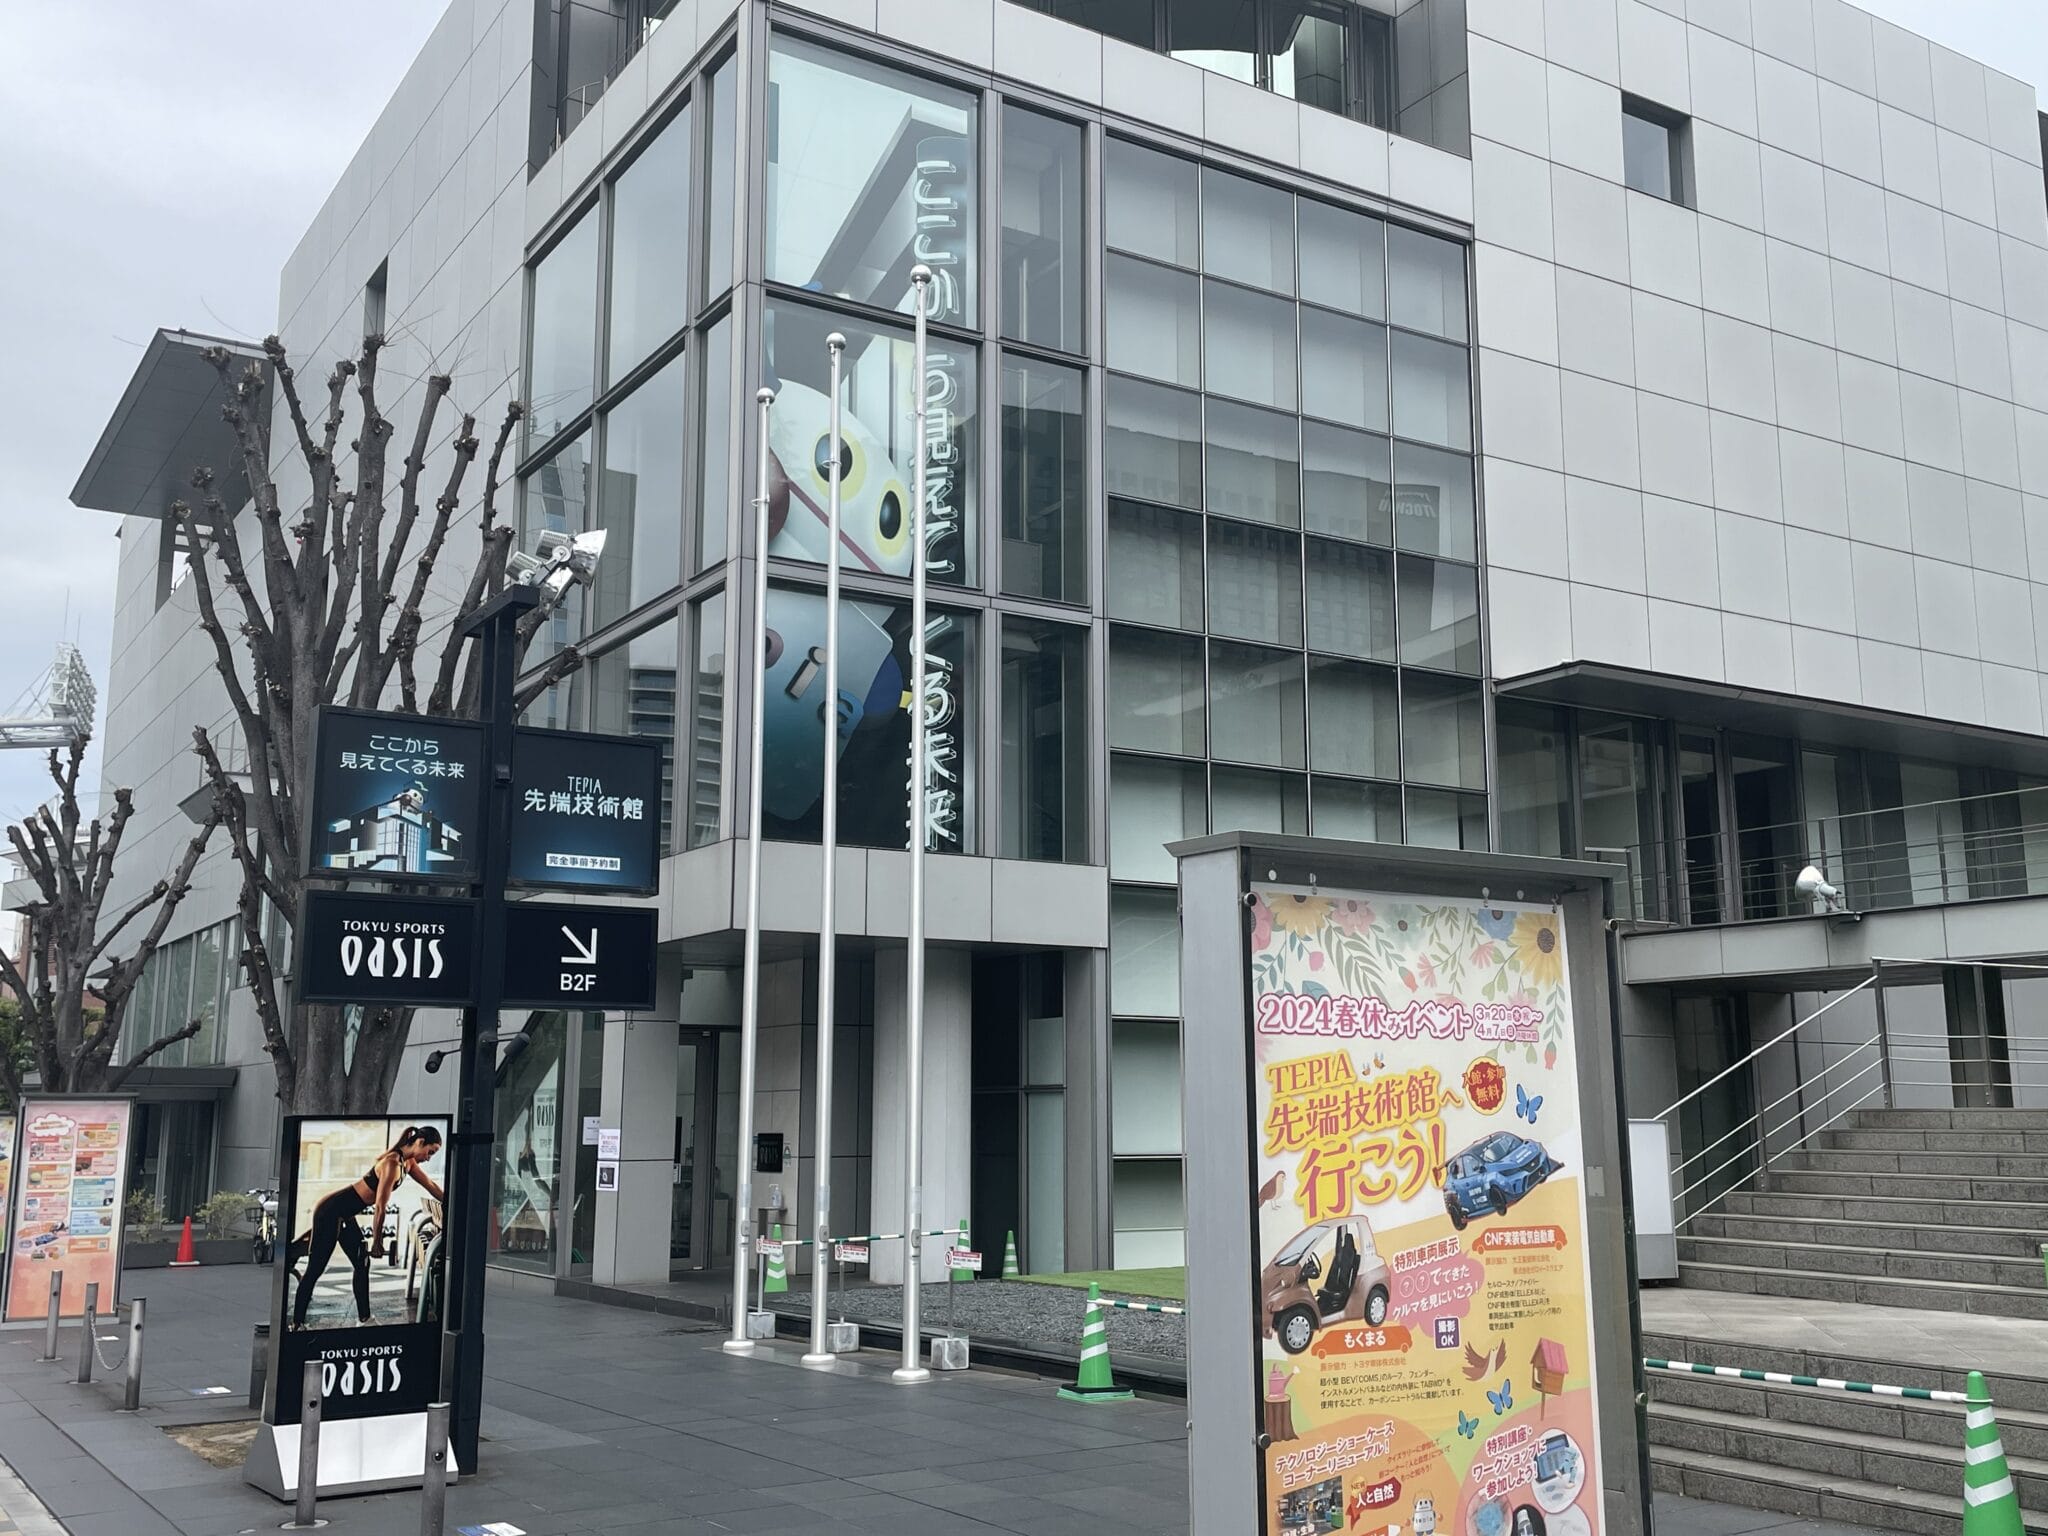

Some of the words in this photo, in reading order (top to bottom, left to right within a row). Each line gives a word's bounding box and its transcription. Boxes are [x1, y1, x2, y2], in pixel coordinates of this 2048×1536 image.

[369, 734, 440, 755] ここから
[339, 751, 466, 779] 見えてくる未来
[567, 776, 603, 795] TEPIA
[523, 788, 644, 820] 先端技術館
[548, 855, 619, 869] 完全事前予約制
[342, 920, 390, 932] TOKYU
[394, 922, 446, 935] SPORTS
[560, 973, 597, 992] B2F
[1261, 997, 1471, 1038] 2024春休みイベント
[1269, 1053, 1353, 1093] TEPIA
[1475, 1084, 1500, 1104] 無料
[1268, 1071, 1462, 1150] 先端技術館へ
[1394, 1237, 1459, 1270] 特別車両展示
[1344, 1330, 1386, 1348] もくまる
[1441, 1335, 1454, 1346] OK
[320, 1348, 358, 1360] TOKYU
[362, 1345, 403, 1358] SPORTS
[1275, 1421, 1395, 1472] テクノロジーショーケース
[1473, 1439, 1547, 1481] ワークショップに
[1350, 1480, 1367, 1490] NEW
[1356, 1484, 1394, 1508] 人と自然
